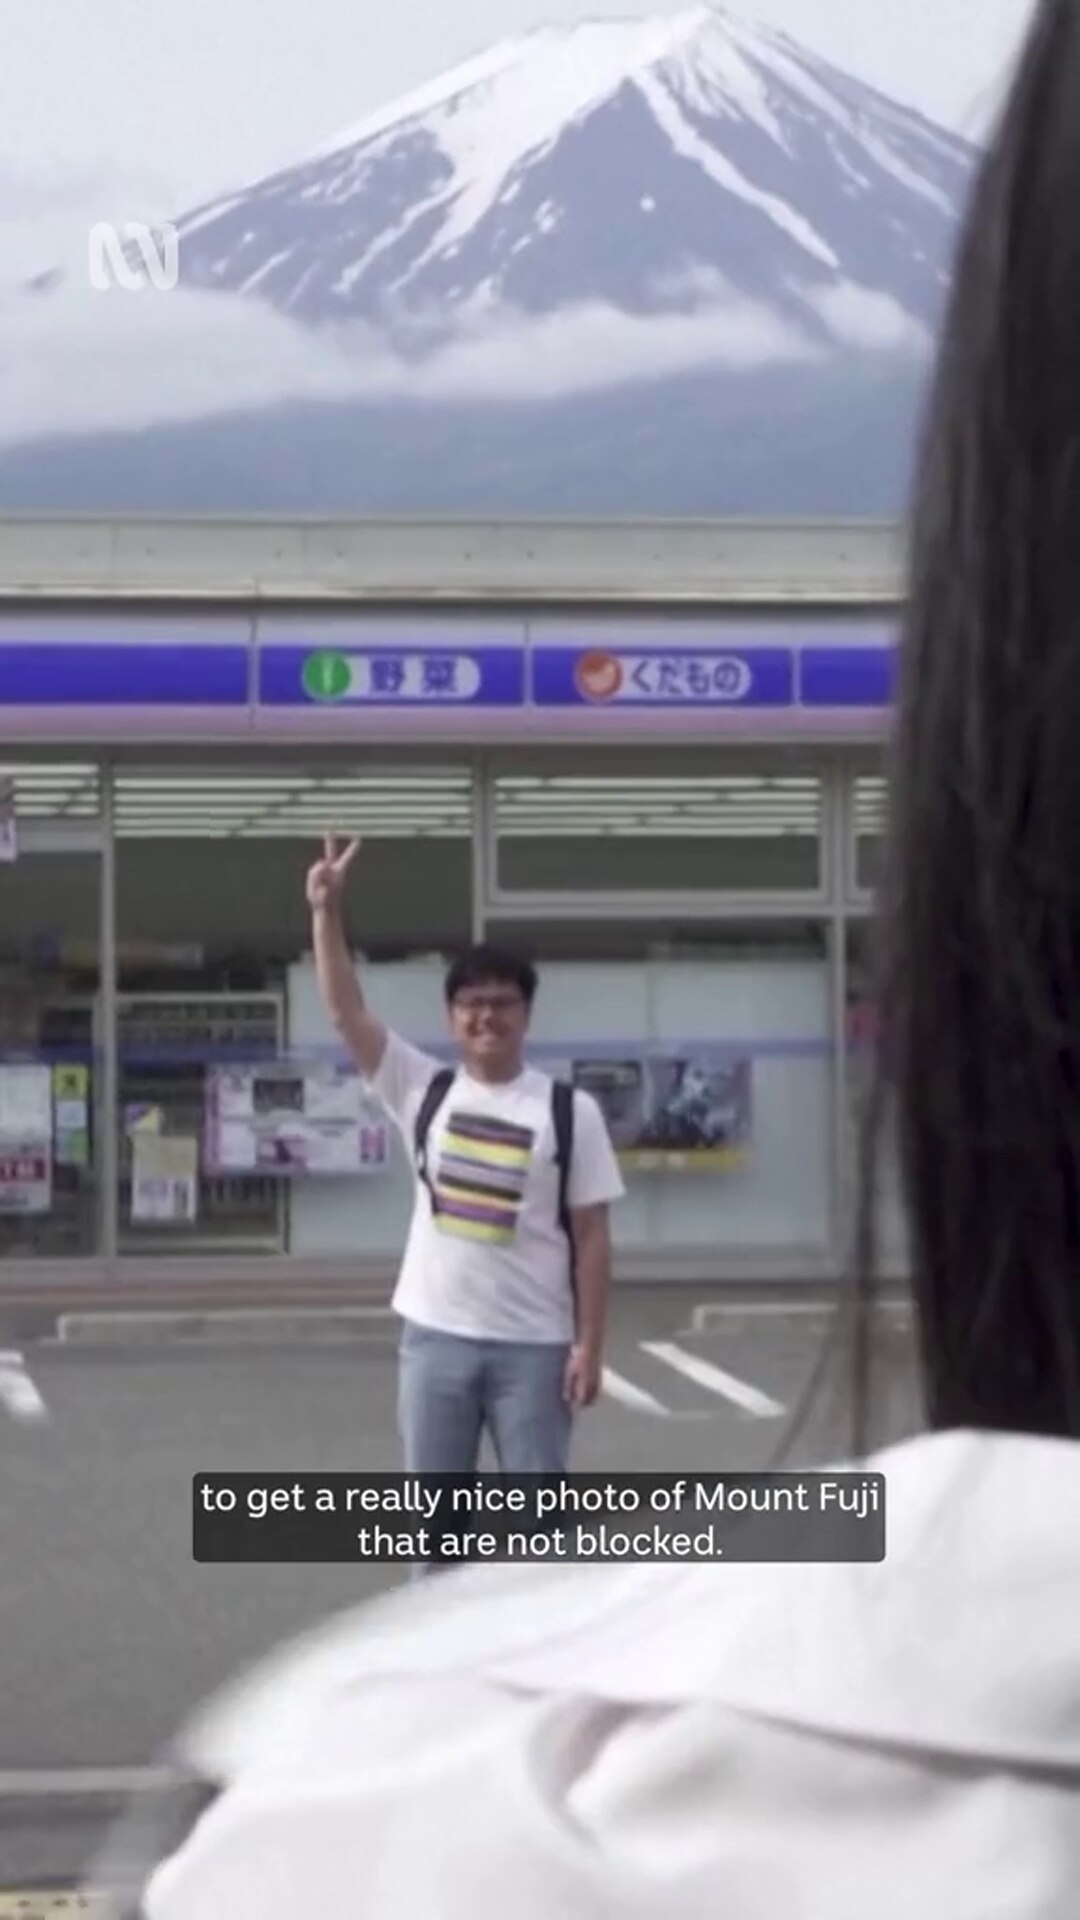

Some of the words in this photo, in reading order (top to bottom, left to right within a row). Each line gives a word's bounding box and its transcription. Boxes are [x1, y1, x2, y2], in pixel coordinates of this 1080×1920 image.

[370, 657, 457, 694] 野菜
[631, 658, 742, 694] くだもの
